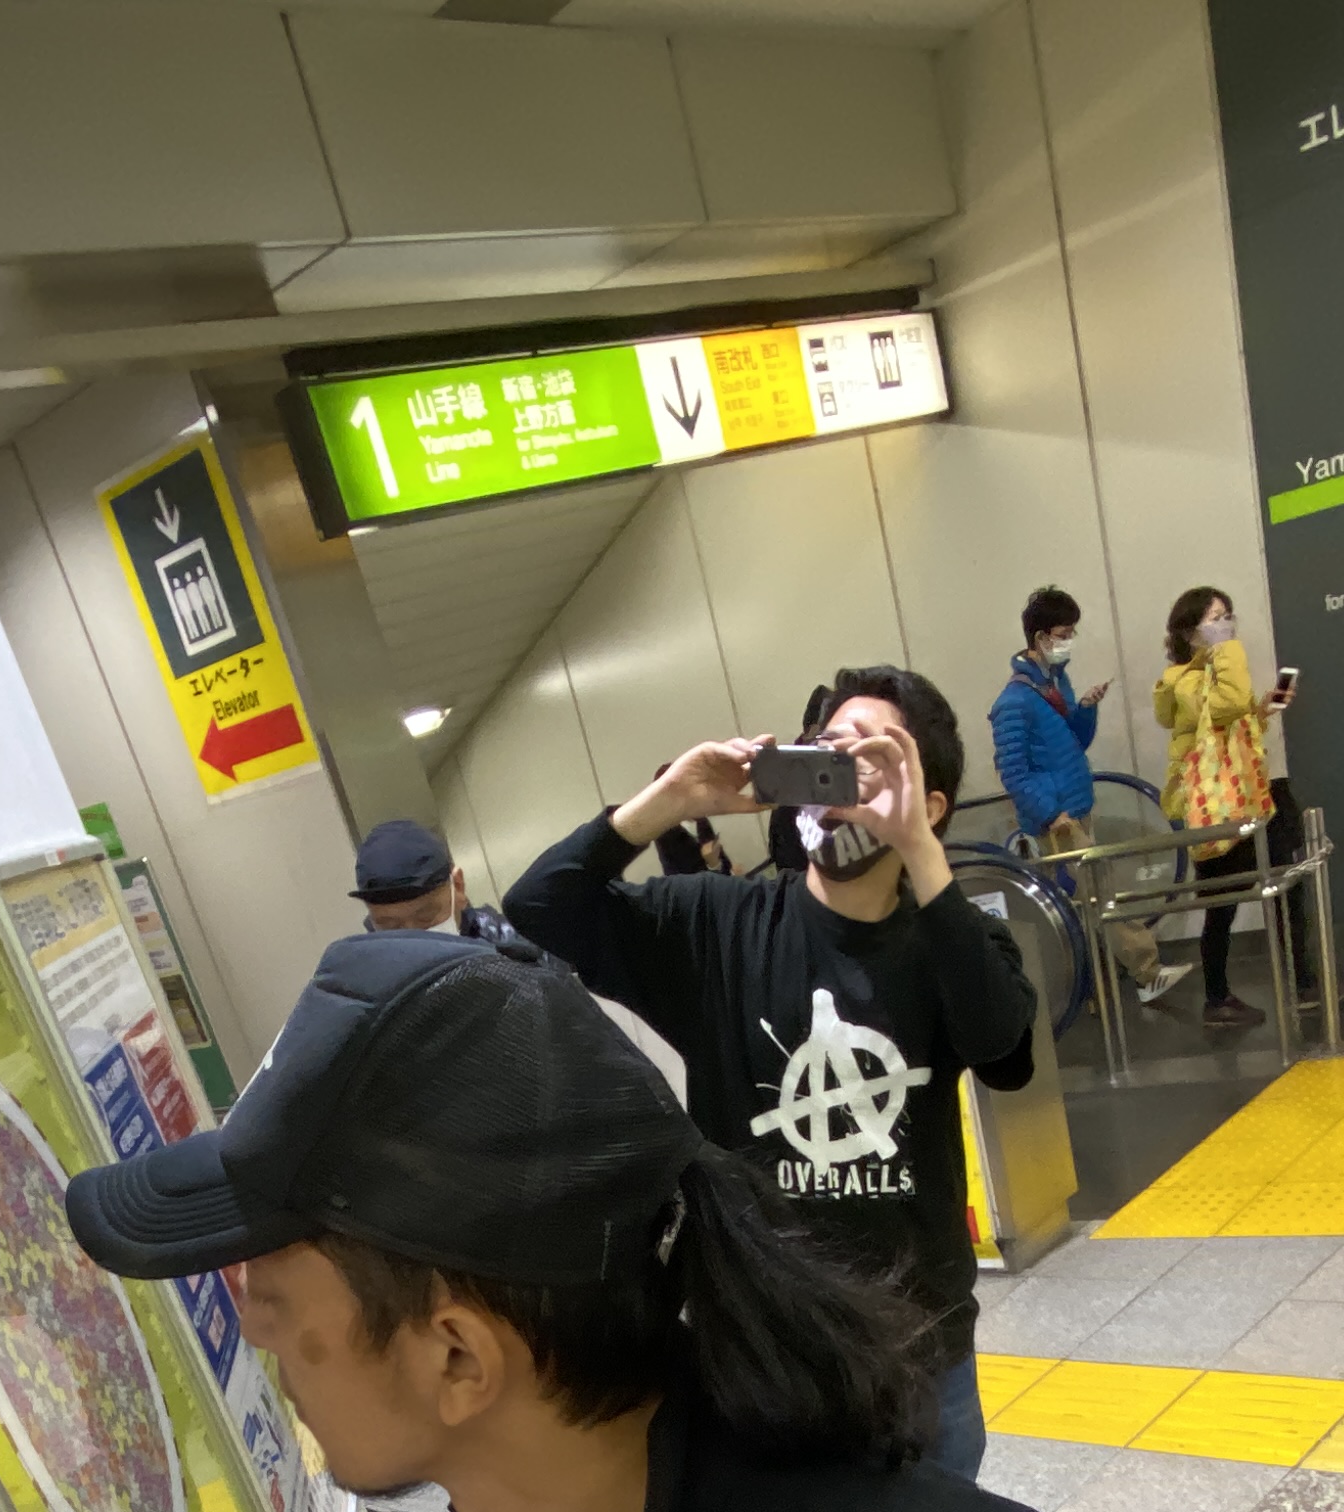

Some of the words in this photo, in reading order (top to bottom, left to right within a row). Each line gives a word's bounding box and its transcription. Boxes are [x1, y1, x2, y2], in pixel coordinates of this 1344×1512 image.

[407, 382, 488, 429] 山手線
[349, 395, 400, 499] 1
[1325, 591, 1344, 612] for
[189, 656, 264, 696] エレベーター
[213, 690, 260, 721] Elevator
